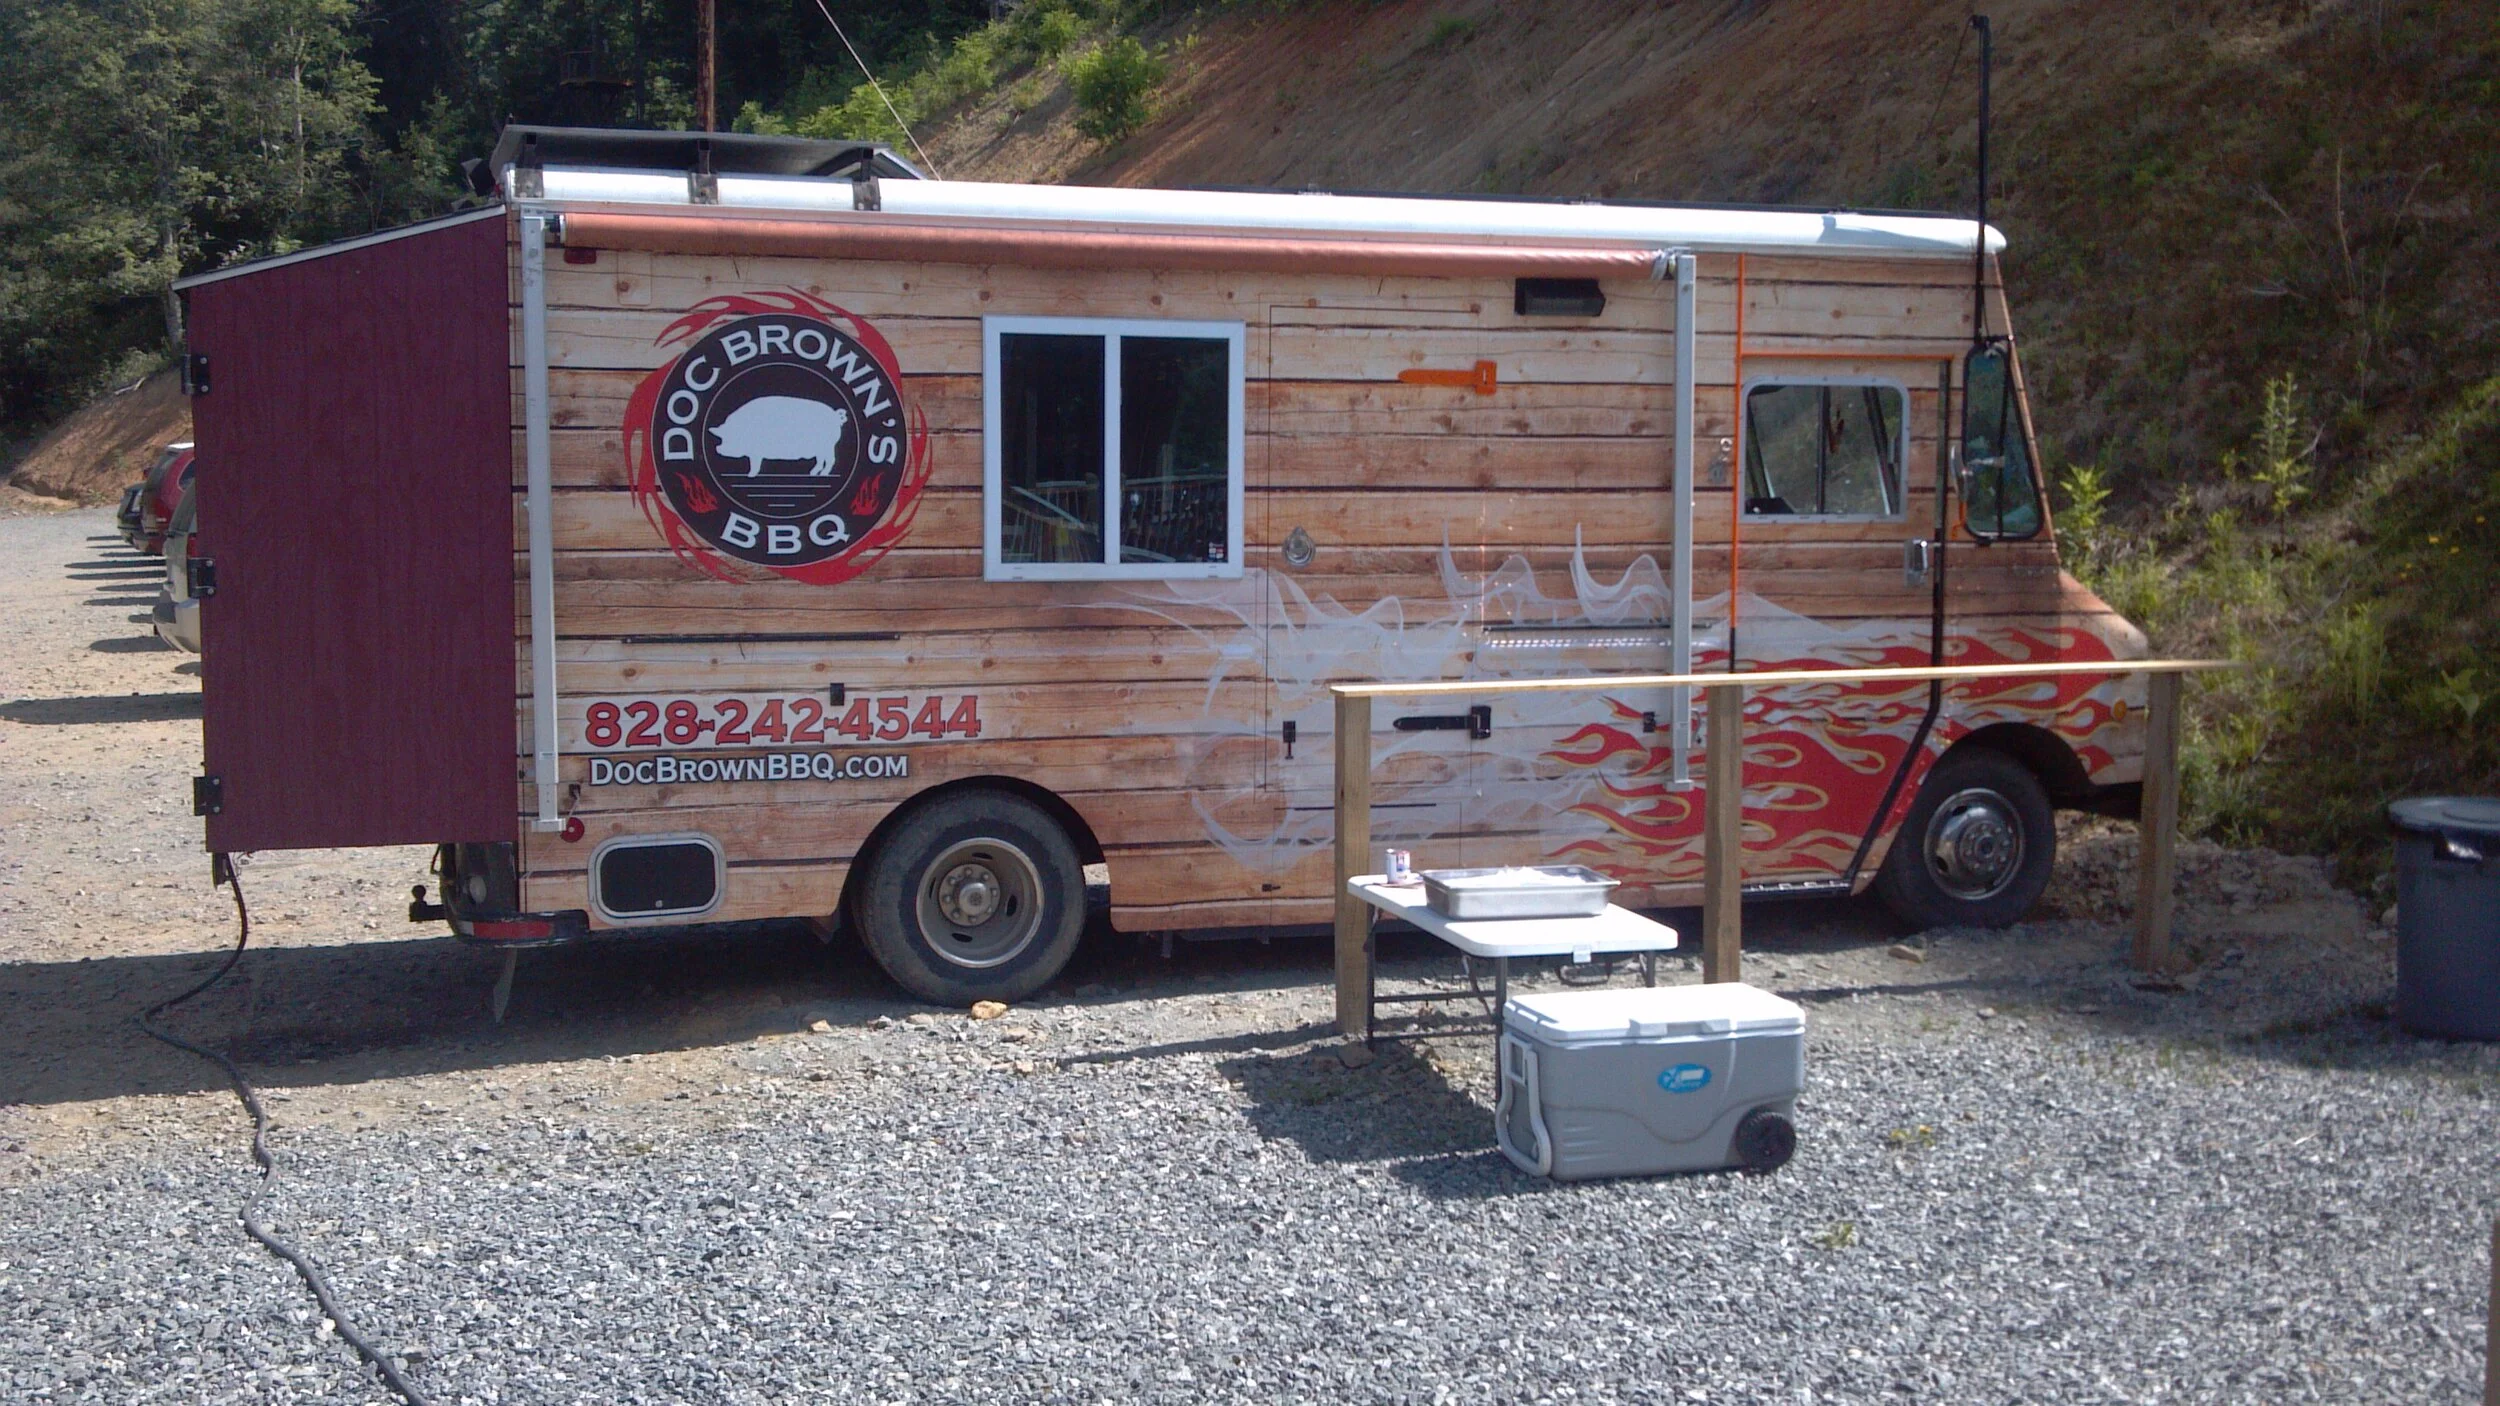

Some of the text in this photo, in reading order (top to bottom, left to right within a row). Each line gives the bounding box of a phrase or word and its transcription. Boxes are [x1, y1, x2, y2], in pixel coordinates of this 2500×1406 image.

[663, 324, 898, 465] DOC BROWN'S
[720, 512, 850, 555] BBQ
[585, 695, 982, 747] 828-242-4544
